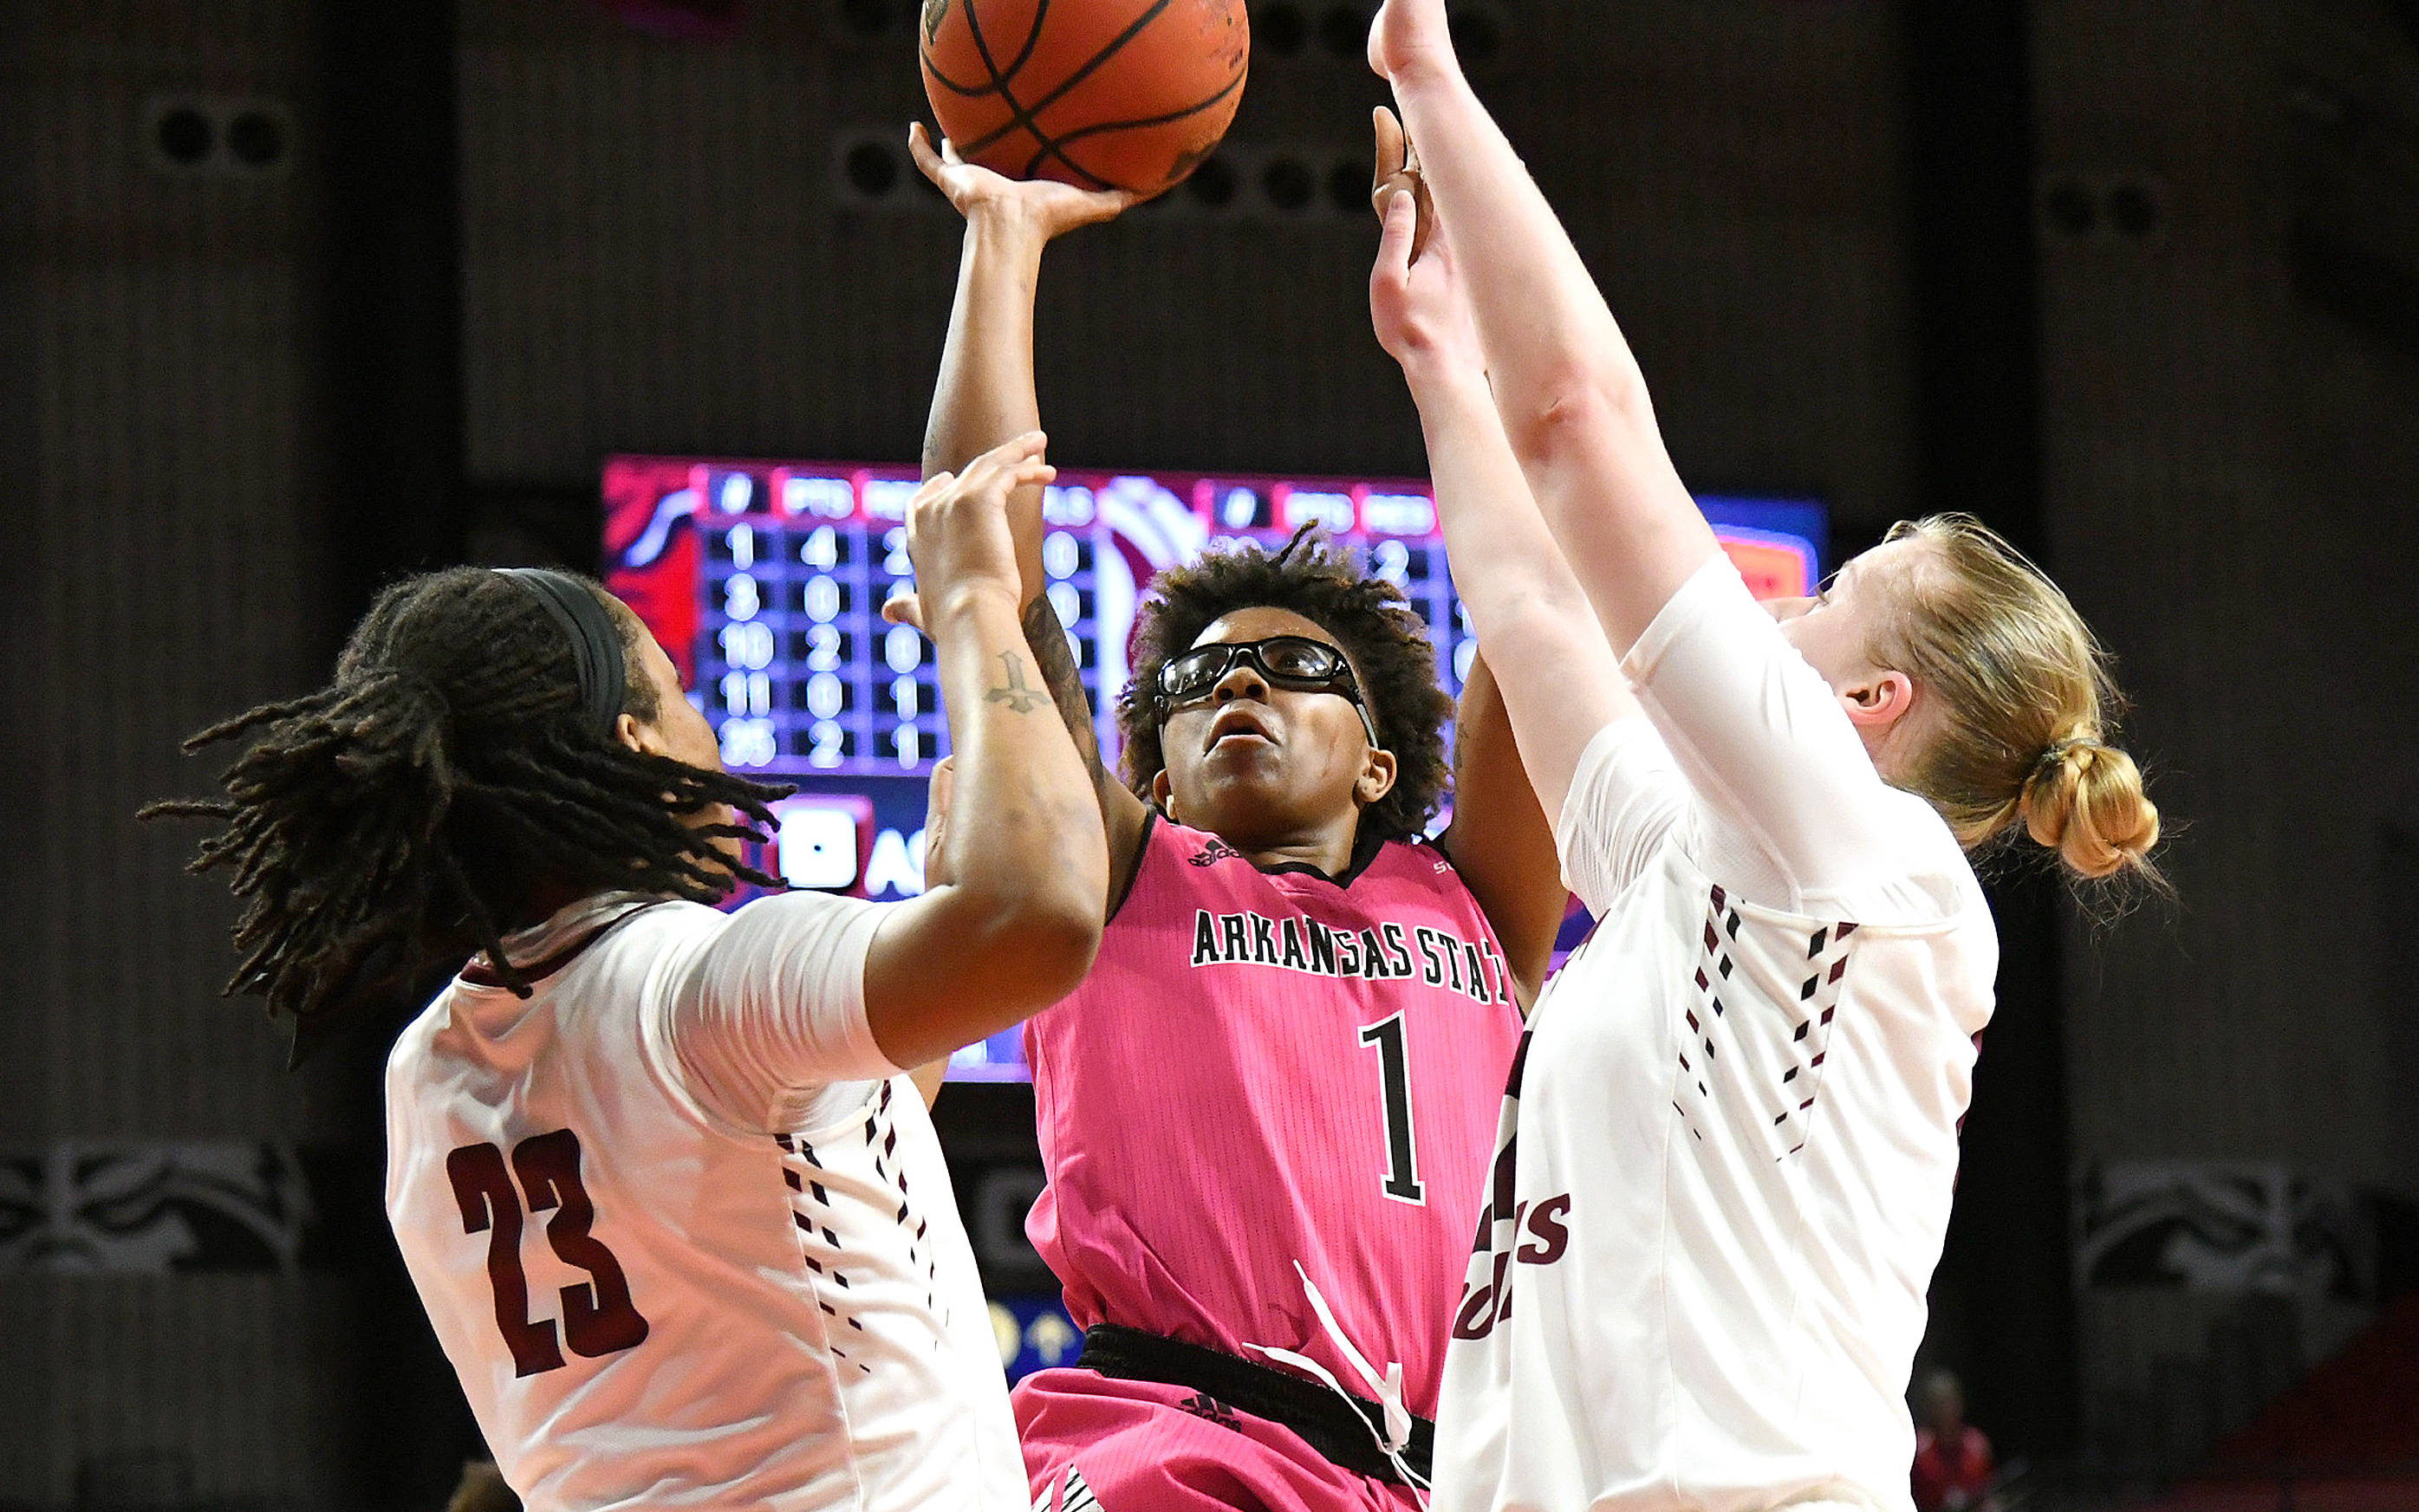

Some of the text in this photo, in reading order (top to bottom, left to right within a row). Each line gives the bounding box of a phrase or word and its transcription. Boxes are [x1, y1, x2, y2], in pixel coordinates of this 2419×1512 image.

[725, 522, 753, 570] 1
[801, 524, 838, 572] 4
[804, 574, 840, 624] 0
[719, 670, 918, 722] 11 0 1
[890, 722, 920, 770] 1
[1190, 908, 1416, 981] ARKANSAS
[1358, 1009, 1427, 1207] 1
[445, 1128, 649, 1379] 23
